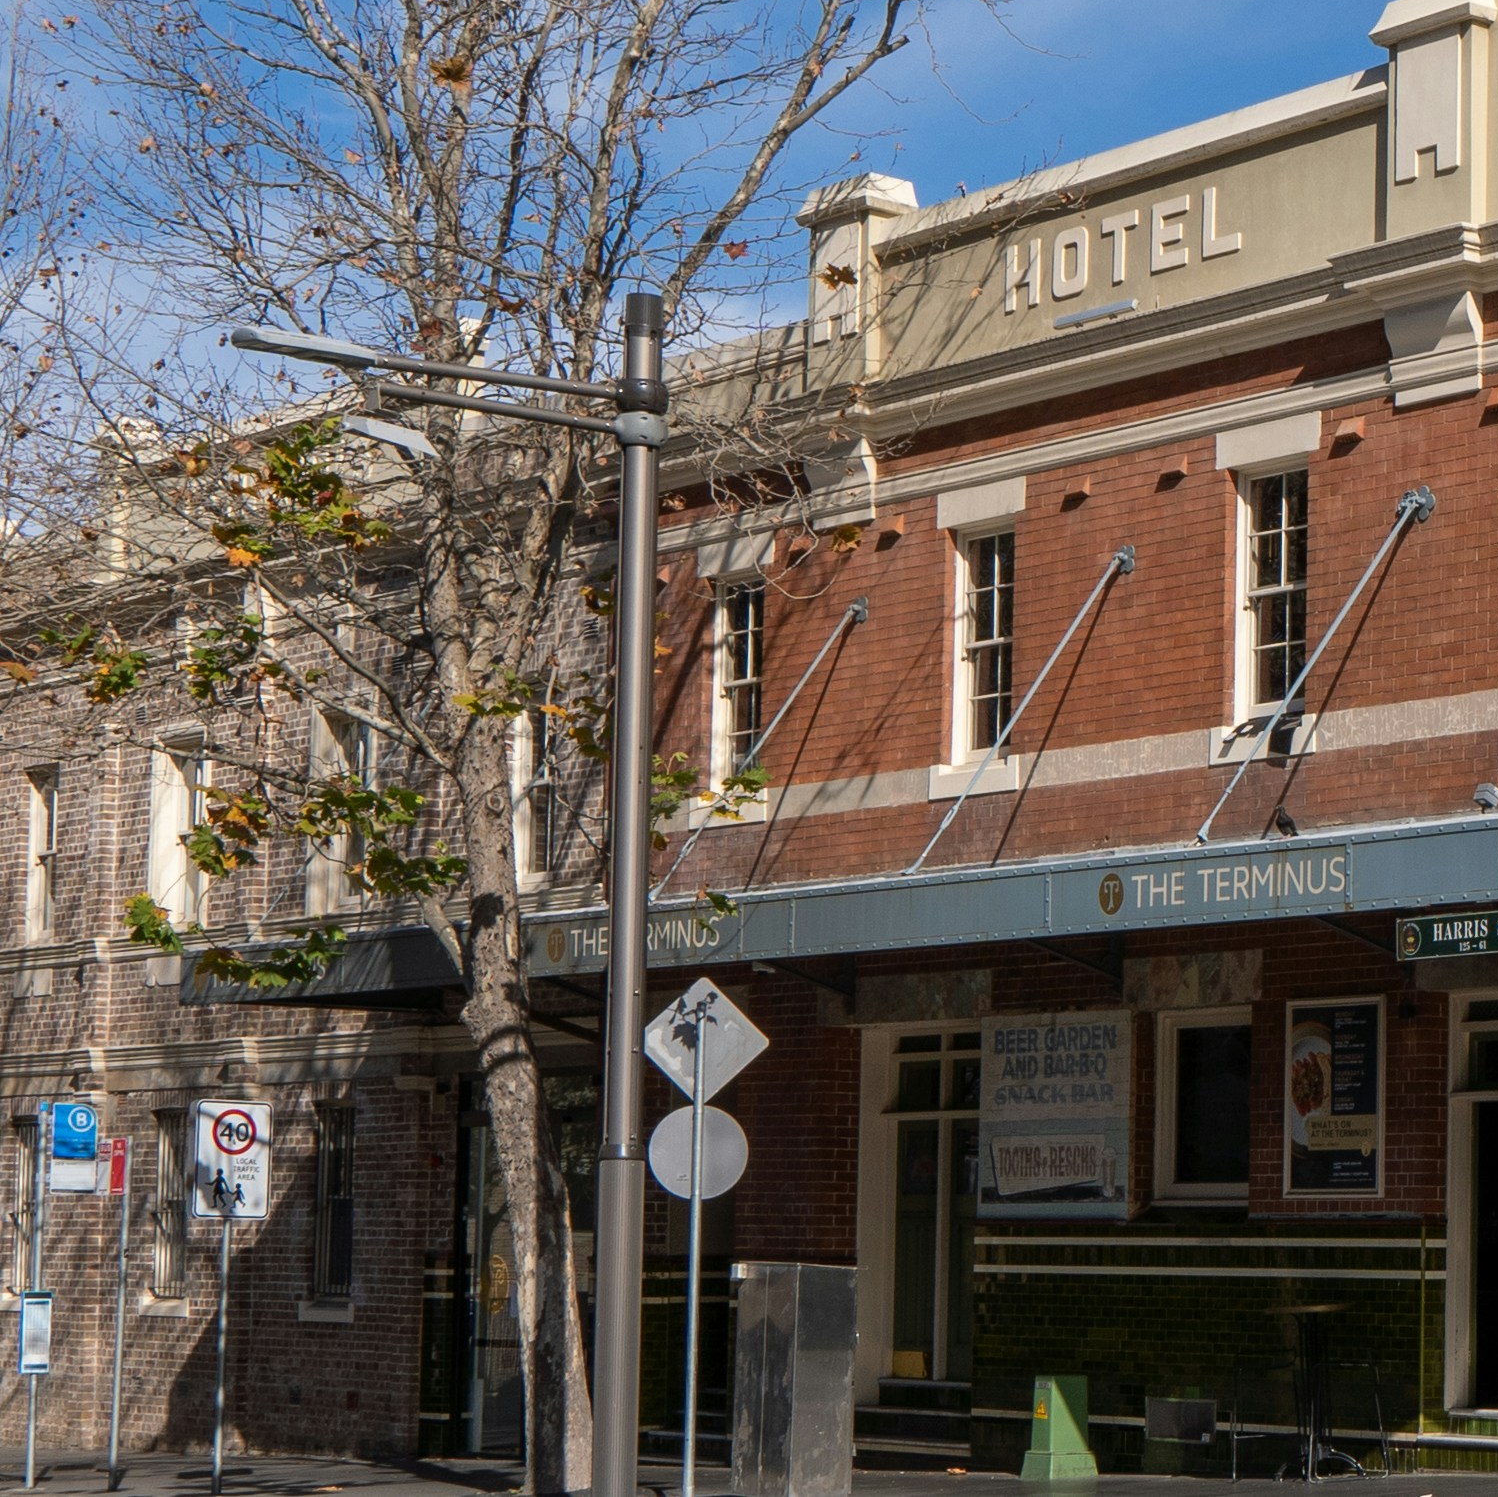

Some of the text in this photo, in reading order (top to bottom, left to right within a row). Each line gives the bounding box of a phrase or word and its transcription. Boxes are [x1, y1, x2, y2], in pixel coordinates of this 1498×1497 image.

[1005, 187, 1242, 314] HOTEL
[1130, 855, 1347, 909] THE TERMINUS
[571, 916, 720, 957] THE RMINUS
[1433, 919, 1488, 941] HARRIS
[1459, 942, 1470, 952] 125
[1479, 940, 1487, 950] 61
[995, 1025, 1116, 1054] BEER GARDEN
[1001, 1055, 1038, 1080] AND
[994, 1084, 1114, 1105] SNACK BAR
[76, 1112, 87, 1126] B
[1311, 1120, 1351, 1129] WHAT'S ON
[220, 1122, 250, 1141] 40
[1311, 1128, 1373, 1138] AT THE TERMINUS?
